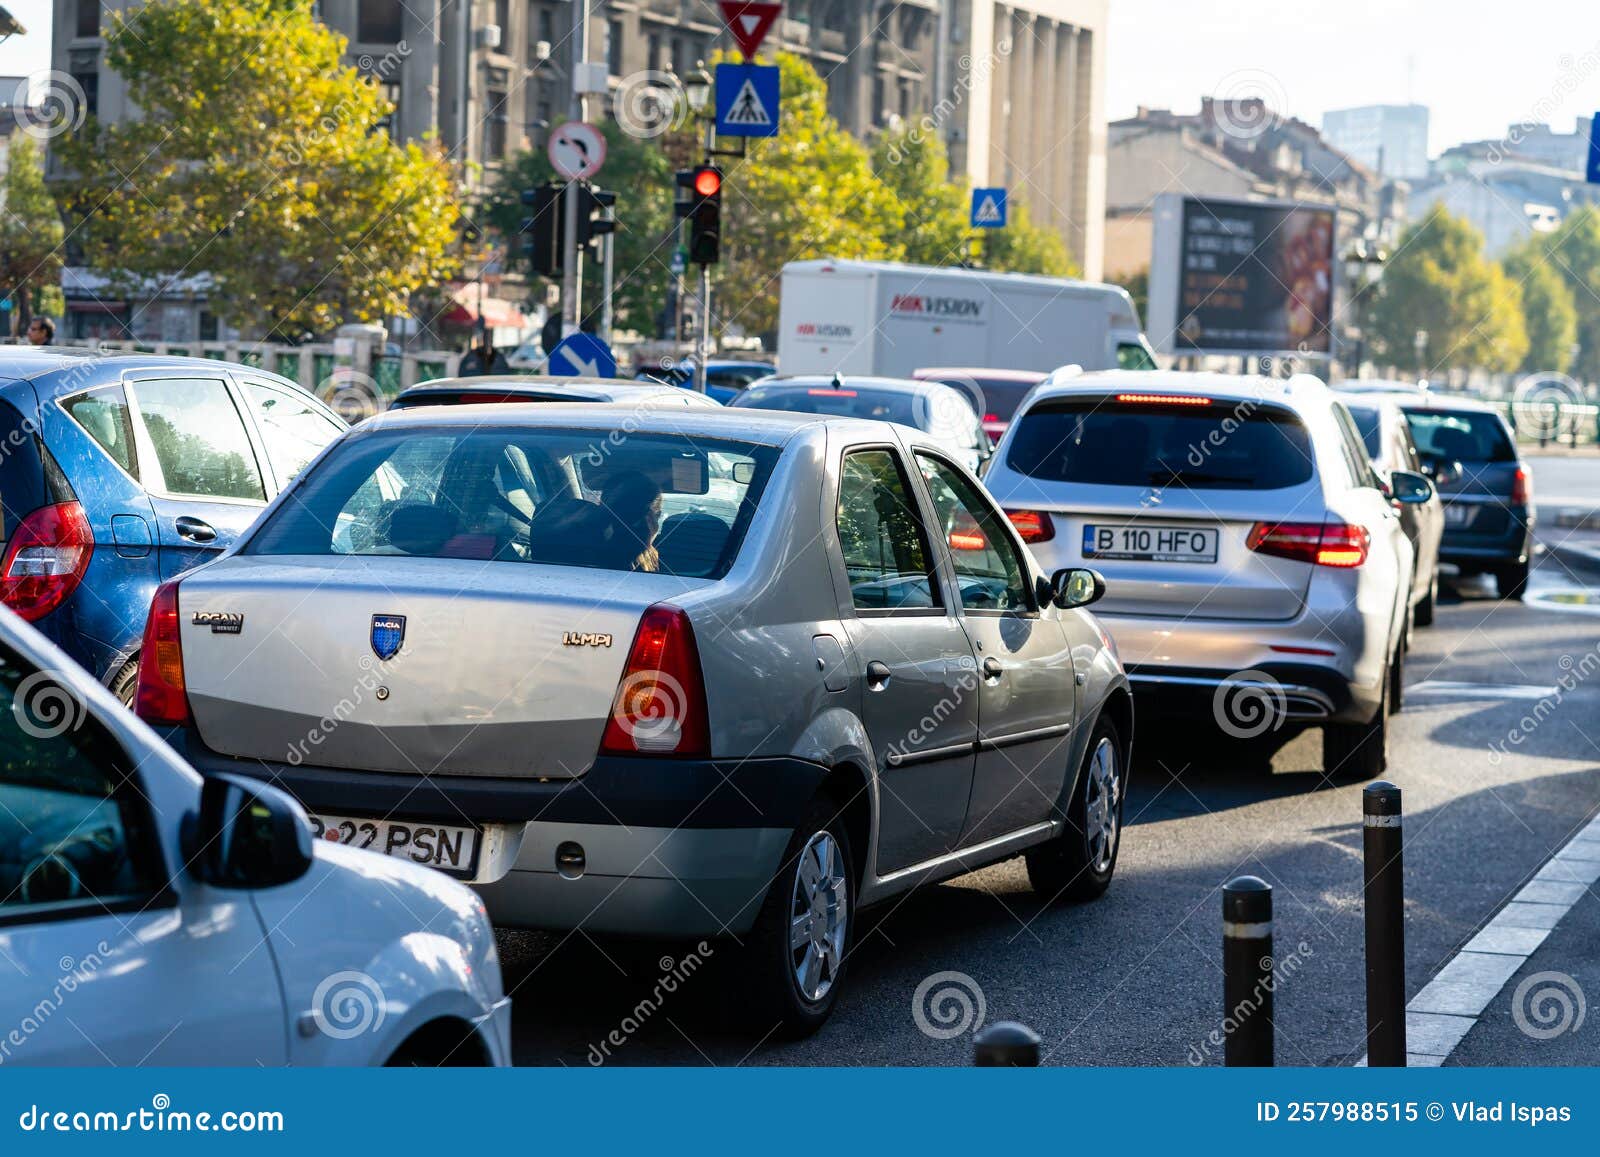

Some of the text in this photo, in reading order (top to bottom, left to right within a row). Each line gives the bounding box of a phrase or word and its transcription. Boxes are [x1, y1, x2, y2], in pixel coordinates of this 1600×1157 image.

[891, 293, 984, 316] HIKVISION
[1098, 529, 1206, 553] B 110 HFO
[192, 611, 244, 625] LOGAN
[374, 621, 400, 629] DACIA
[386, 824, 463, 866] PSN
